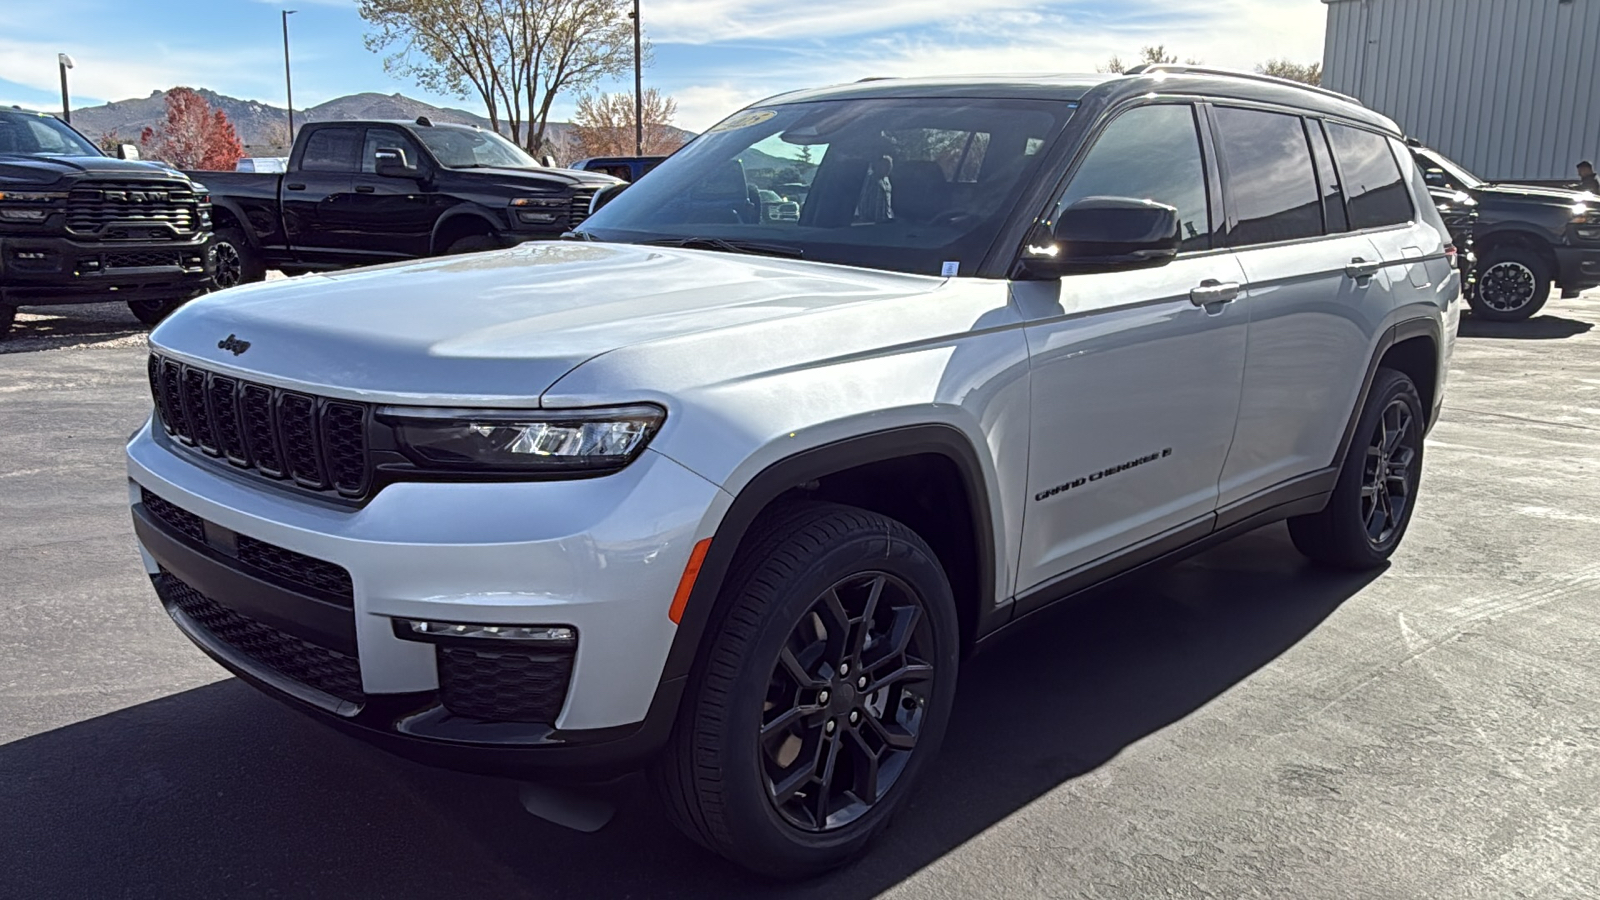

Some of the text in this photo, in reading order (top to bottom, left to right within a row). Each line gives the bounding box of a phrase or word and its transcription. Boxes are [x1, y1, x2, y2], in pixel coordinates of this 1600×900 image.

[103, 190, 169, 203] RAM
[217, 333, 252, 357] Jeep
[1034, 476, 1087, 502] GRAND
[1088, 451, 1160, 483] CHEROKEE
